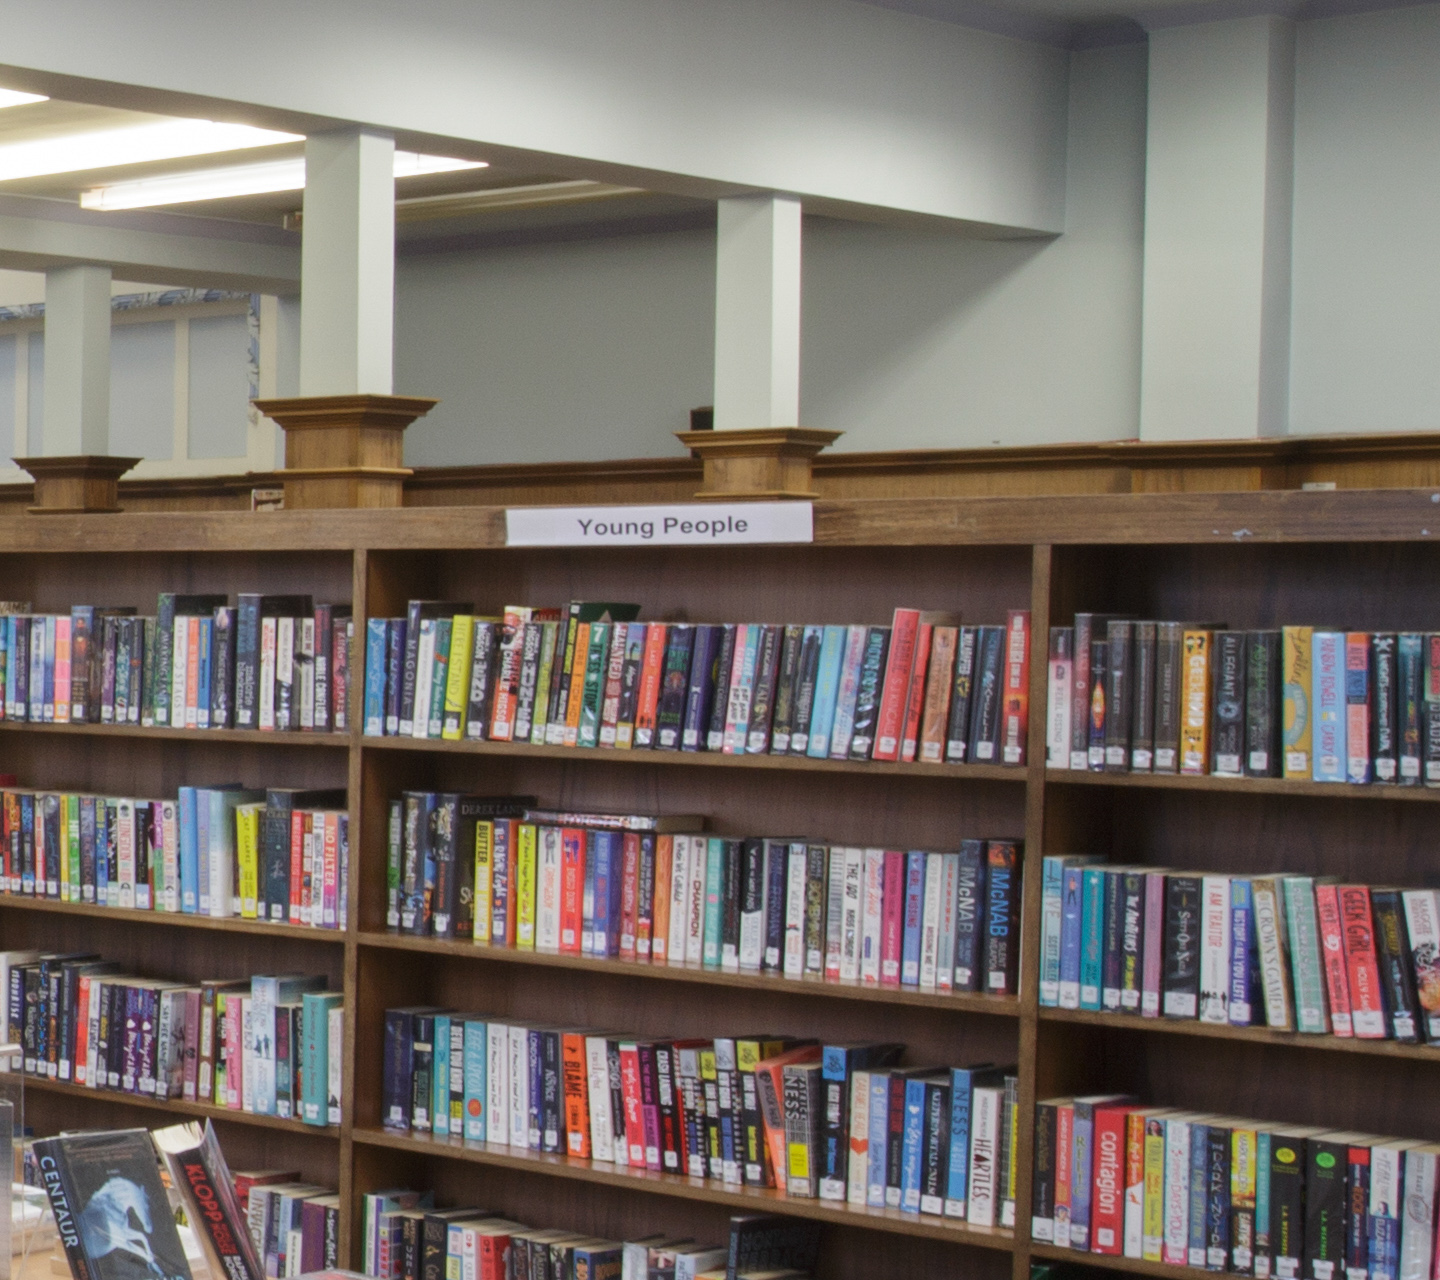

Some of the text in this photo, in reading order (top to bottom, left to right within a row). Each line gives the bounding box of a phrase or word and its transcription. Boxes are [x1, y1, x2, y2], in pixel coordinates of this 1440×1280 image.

[578, 516, 749, 540] Young People
[455, 623, 466, 649] HERE
[608, 629, 627, 680] HAUNTED
[245, 665, 254, 705] malorie
[404, 640, 416, 704] MAGONIA
[448, 660, 462, 695] STAND
[1222, 636, 1235, 697] ALLEGIANT
[644, 676, 654, 714] BEGINNING
[1321, 638, 1336, 753] RAINBOW ROWELL CARRY
[243, 817, 252, 863] CAT CLARKE
[324, 825, 335, 886] NO FILTER
[478, 824, 488, 863] BUTTER
[691, 880, 701, 938] CHAMPION
[959, 874, 975, 933] McNAB
[989, 872, 1010, 937] McNAB
[1209, 892, 1221, 906] AM
[1421, 899, 1431, 935] MAGGIE
[925, 926, 935, 965] MISSING ME
[1209, 910, 1222, 948] TRAITOR
[1343, 890, 1371, 956] GEEK GIRL
[989, 938, 998, 970] WEAPON
[1260, 907, 1282, 1005] CROWN'S GAME
[450, 1026, 463, 1092] DEVIL YOU KNOW
[530, 1032, 538, 1067] LONDON
[590, 1052, 604, 1089] twilight
[566, 1061, 580, 1098] BLAME
[785, 1075, 799, 1120] NESS
[799, 1077, 809, 1120] PATRICK
[953, 1088, 968, 1136] NESS
[184, 1164, 224, 1224] KLOPP
[1096, 1131, 1120, 1214] contagion
[41, 1156, 79, 1248] CENTAUR
